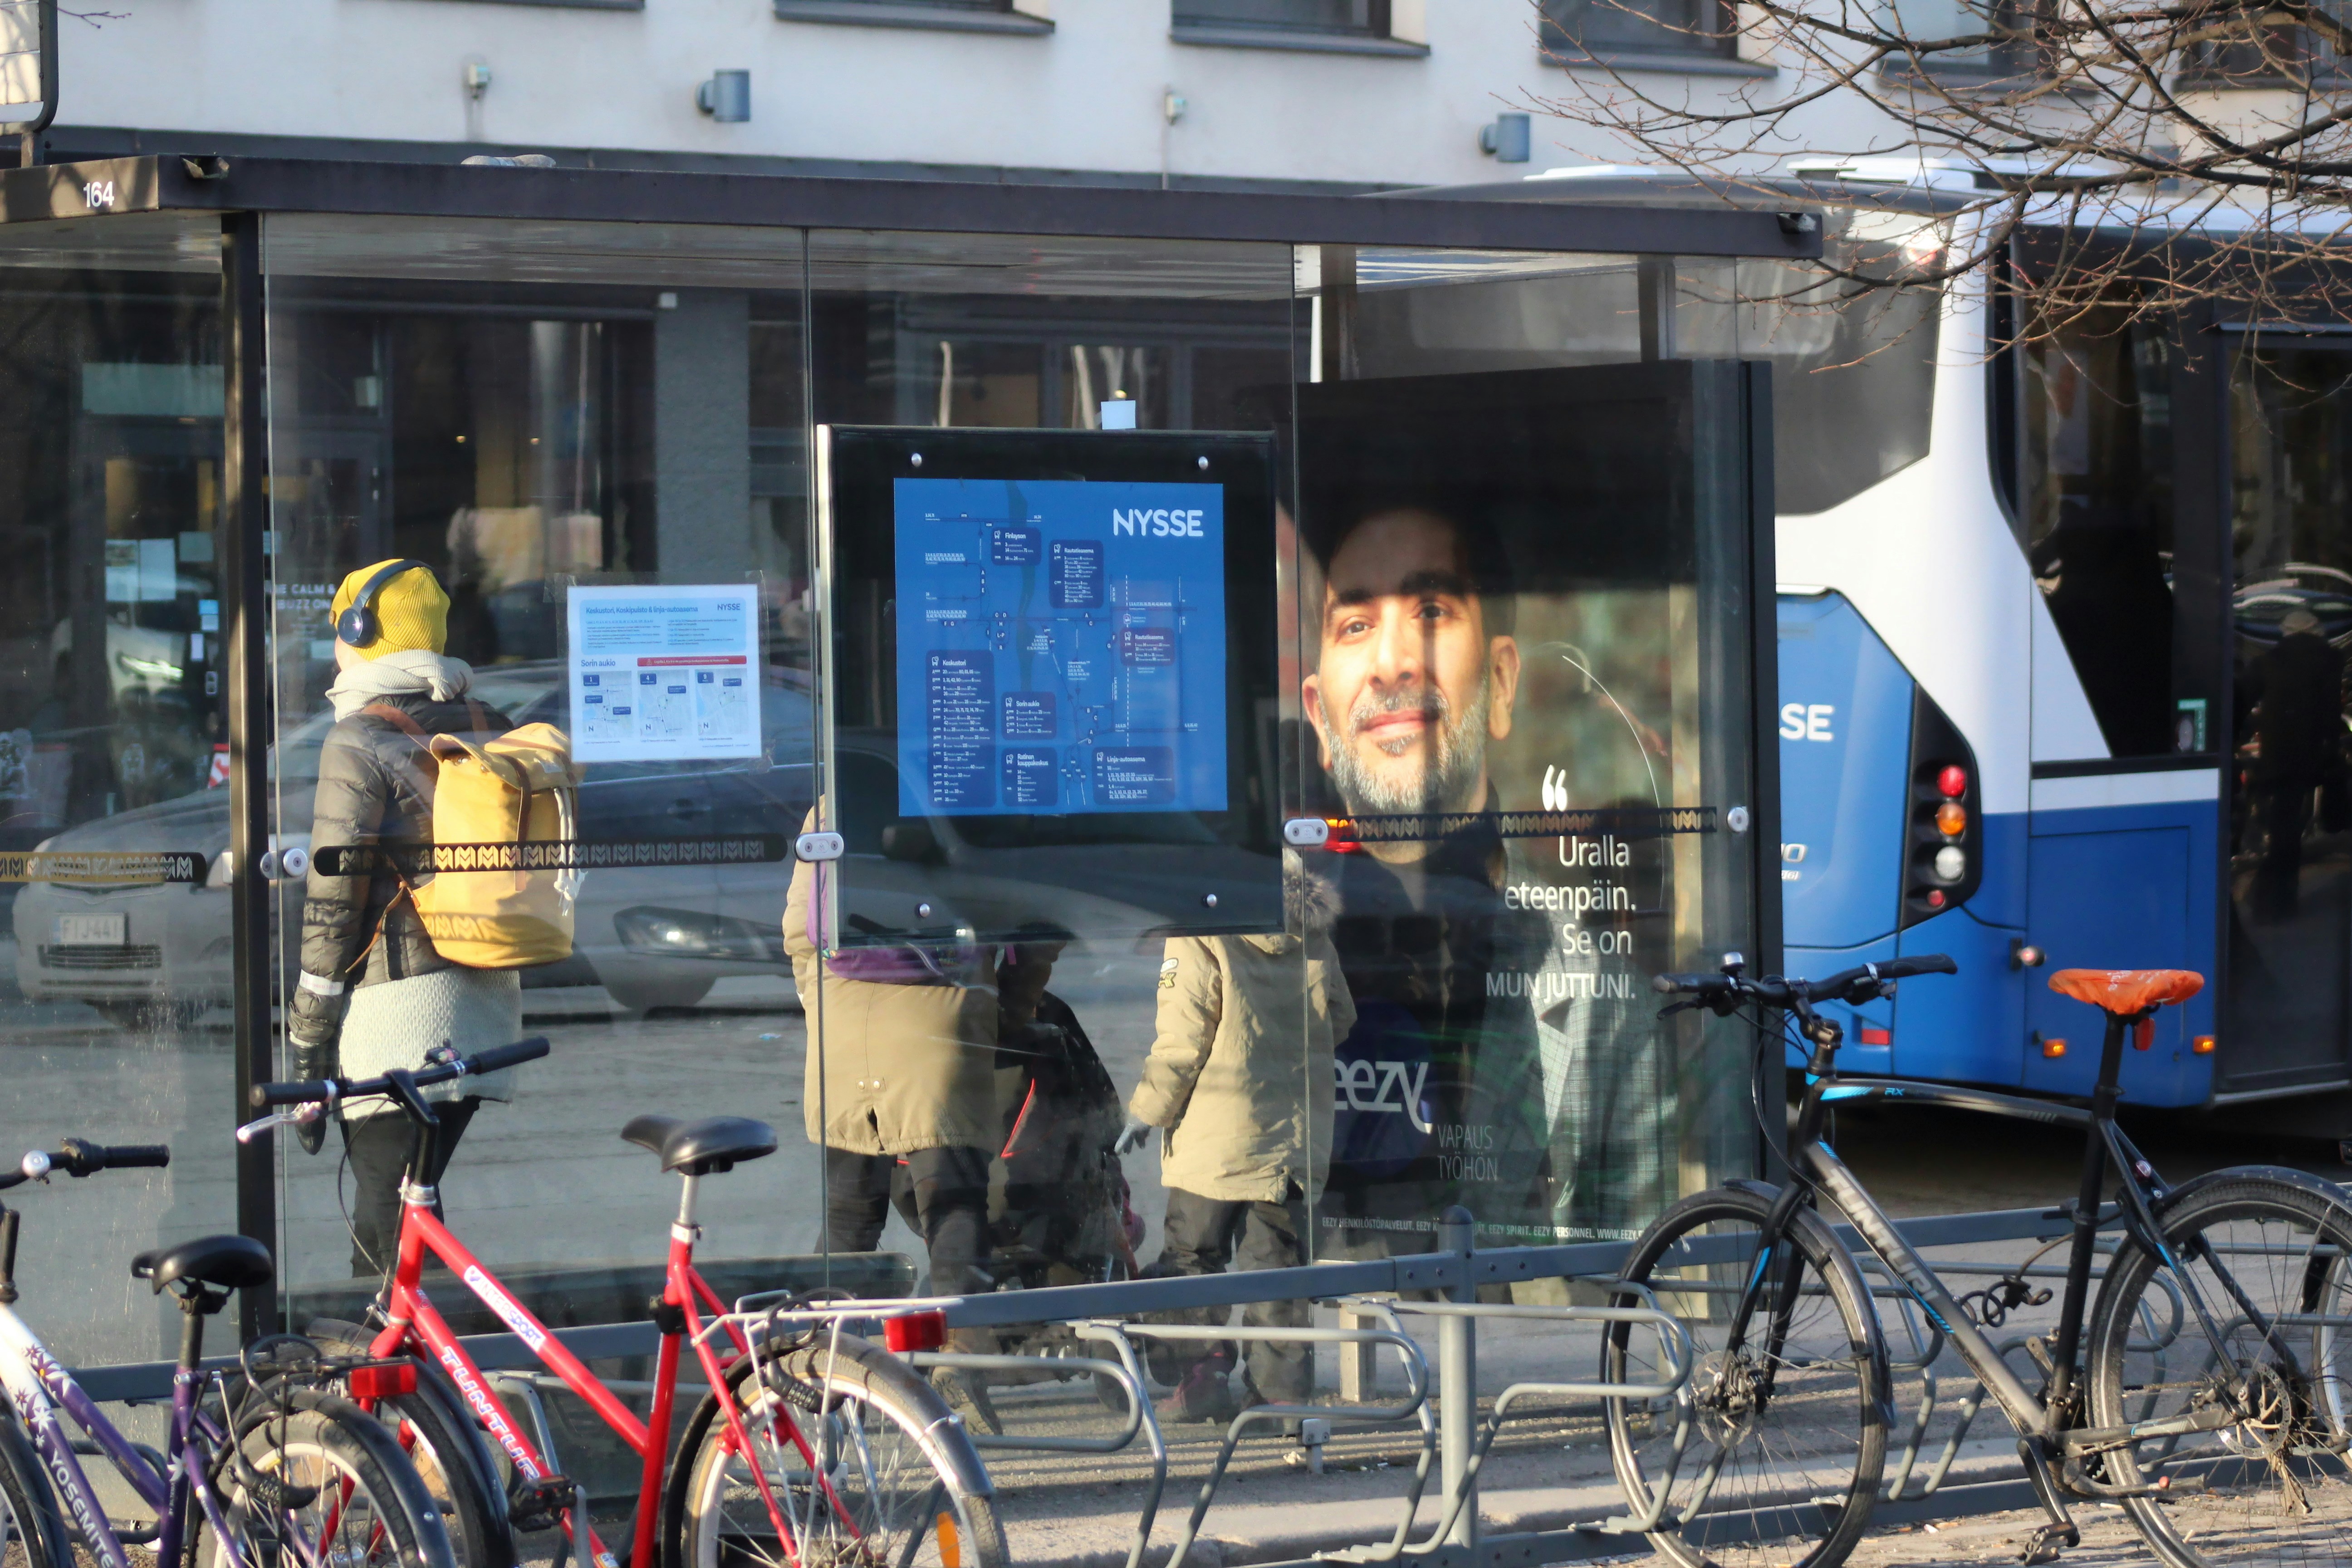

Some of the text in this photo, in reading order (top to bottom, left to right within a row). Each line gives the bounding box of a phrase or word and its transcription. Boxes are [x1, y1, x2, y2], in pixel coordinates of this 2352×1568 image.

[83, 181, 114, 207] 164
[1113, 509, 1203, 536] NYSSE
[616, 606, 648, 614] Koskipuisto
[653, 606, 698, 614] linja-autoasema
[1559, 834, 1630, 867] Uralla
[1504, 879, 1636, 920] eteenpäin.
[1563, 923, 1632, 955] Se on
[1486, 972, 1636, 1003] MUN JUTTUNI.
[1438, 1124, 1493, 1149] VAPAUS
[1438, 1152, 1497, 1181] TYÖHÖN
[1322, 1217, 1337, 1227] EEZY
[1339, 1217, 1414, 1231] HENKILÖSTÖPALVELUT.
[1416, 1220, 1430, 1231] EEZY
[1489, 1224, 1503, 1235] EEZY
[1506, 1225, 1531, 1236] SPIRIT.
[1534, 1226, 1550, 1237] EEZY
[1553, 1227, 1595, 1239] PERSONNEL.
[1825, 1168, 1940, 1301] TUNTURI
[477, 1281, 541, 1347] INTERSPORT
[50, 1447, 115, 1568] YOSEMITE
